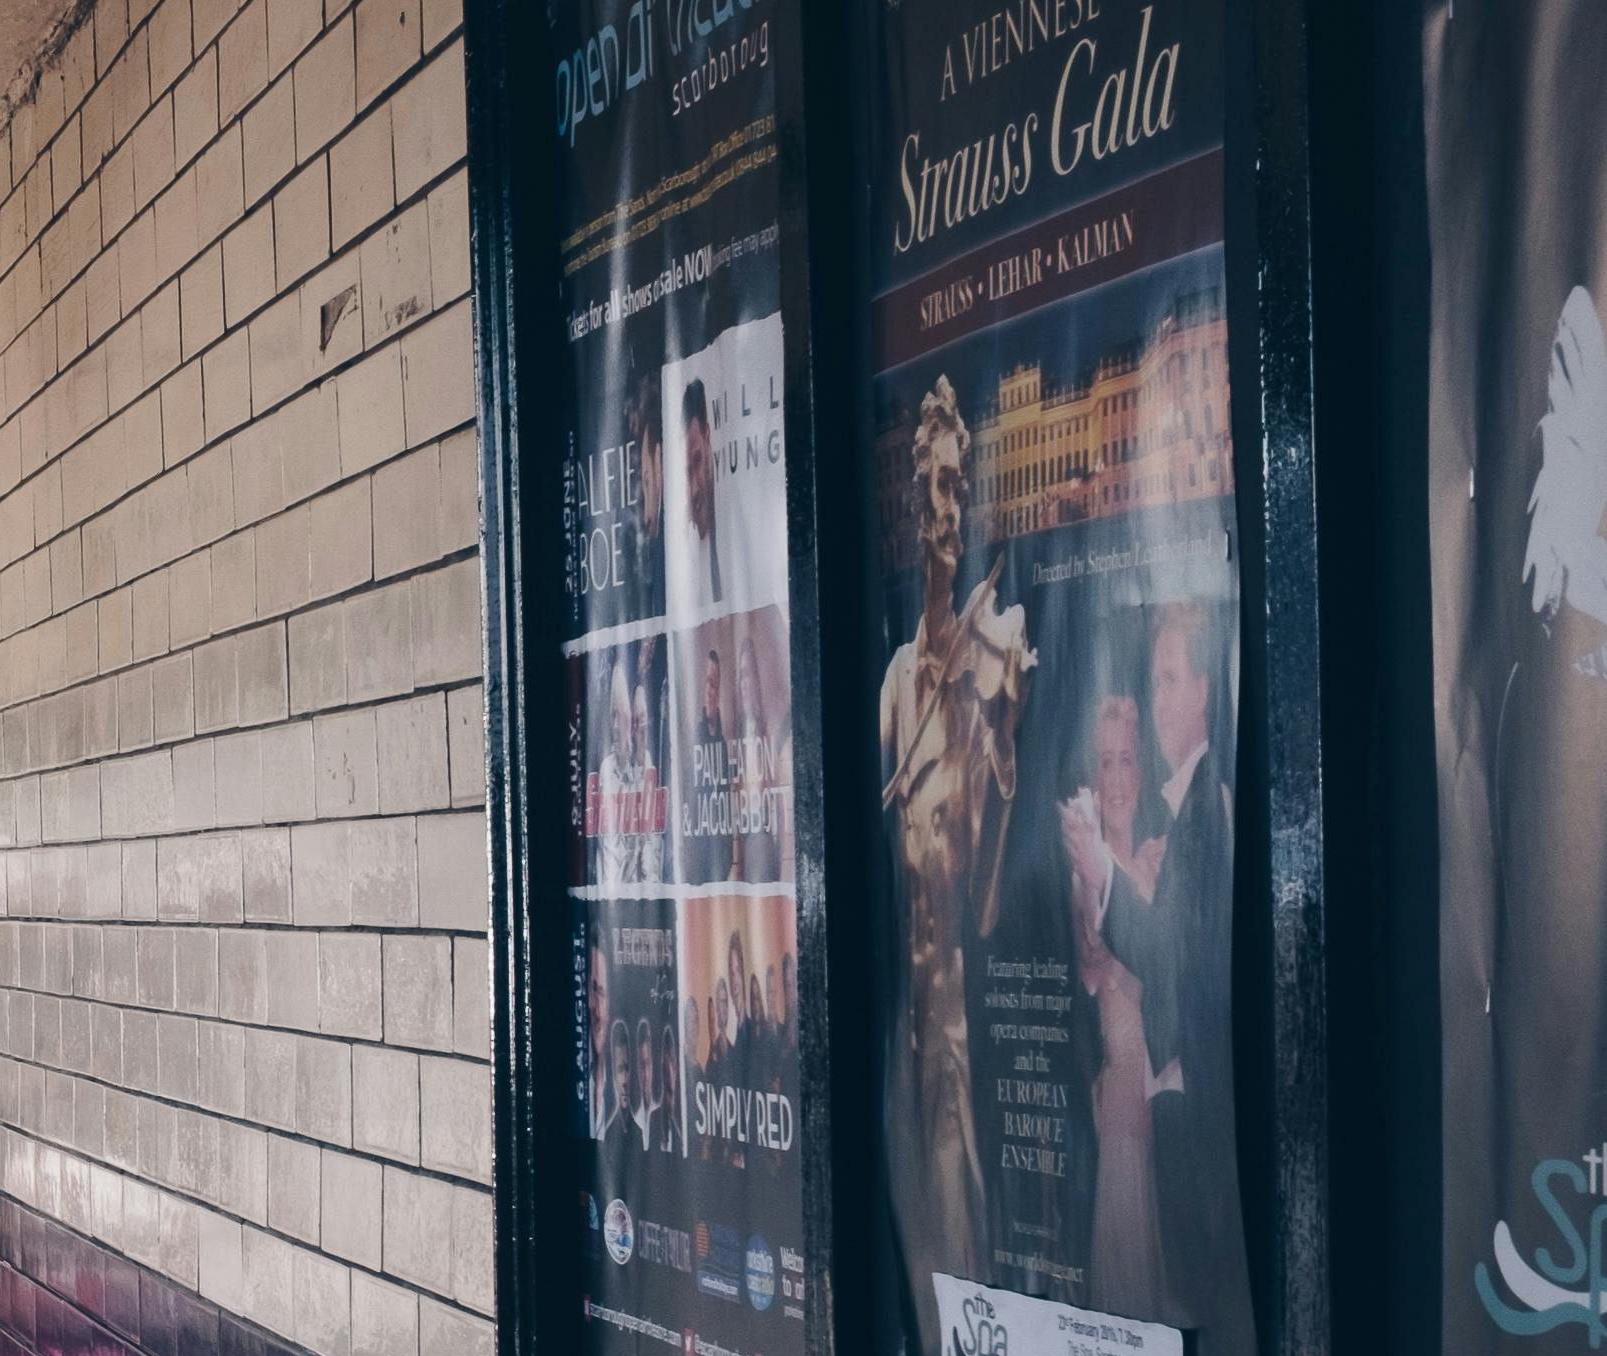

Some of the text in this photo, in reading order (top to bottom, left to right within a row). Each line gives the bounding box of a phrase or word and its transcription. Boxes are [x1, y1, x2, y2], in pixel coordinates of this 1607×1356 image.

[556, 24, 619, 149] open
[625, 0, 654, 92] ai
[672, 20, 769, 117] scarboroug
[941, 0, 1100, 100] A VIENNE
[893, 5, 1180, 256] Strauss Gala
[589, 299, 604, 331] for
[604, 287, 622, 324] all
[622, 283, 653, 319] shows
[659, 258, 683, 296] sale
[920, 209, 1135, 332] STRAUSS LEHAR KALMAN
[712, 375, 779, 430] WILL
[577, 440, 638, 521] ALFIE
[579, 522, 626, 595] BOE
[693, 742, 727, 787] PAUL
[682, 801, 692, 837] &
[694, 790, 732, 837] JACQU
[572, 932, 584, 1072] AUGUST
[990, 1022, 1018, 1046] opera
[1020, 987, 1044, 1011] from
[1014, 1049, 1051, 1073] and the
[695, 1080, 793, 1152] SIMPLY RED
[1003, 1110, 1065, 1145] BAROQUE
[1001, 1143, 1067, 1178] ENSEMBLE
